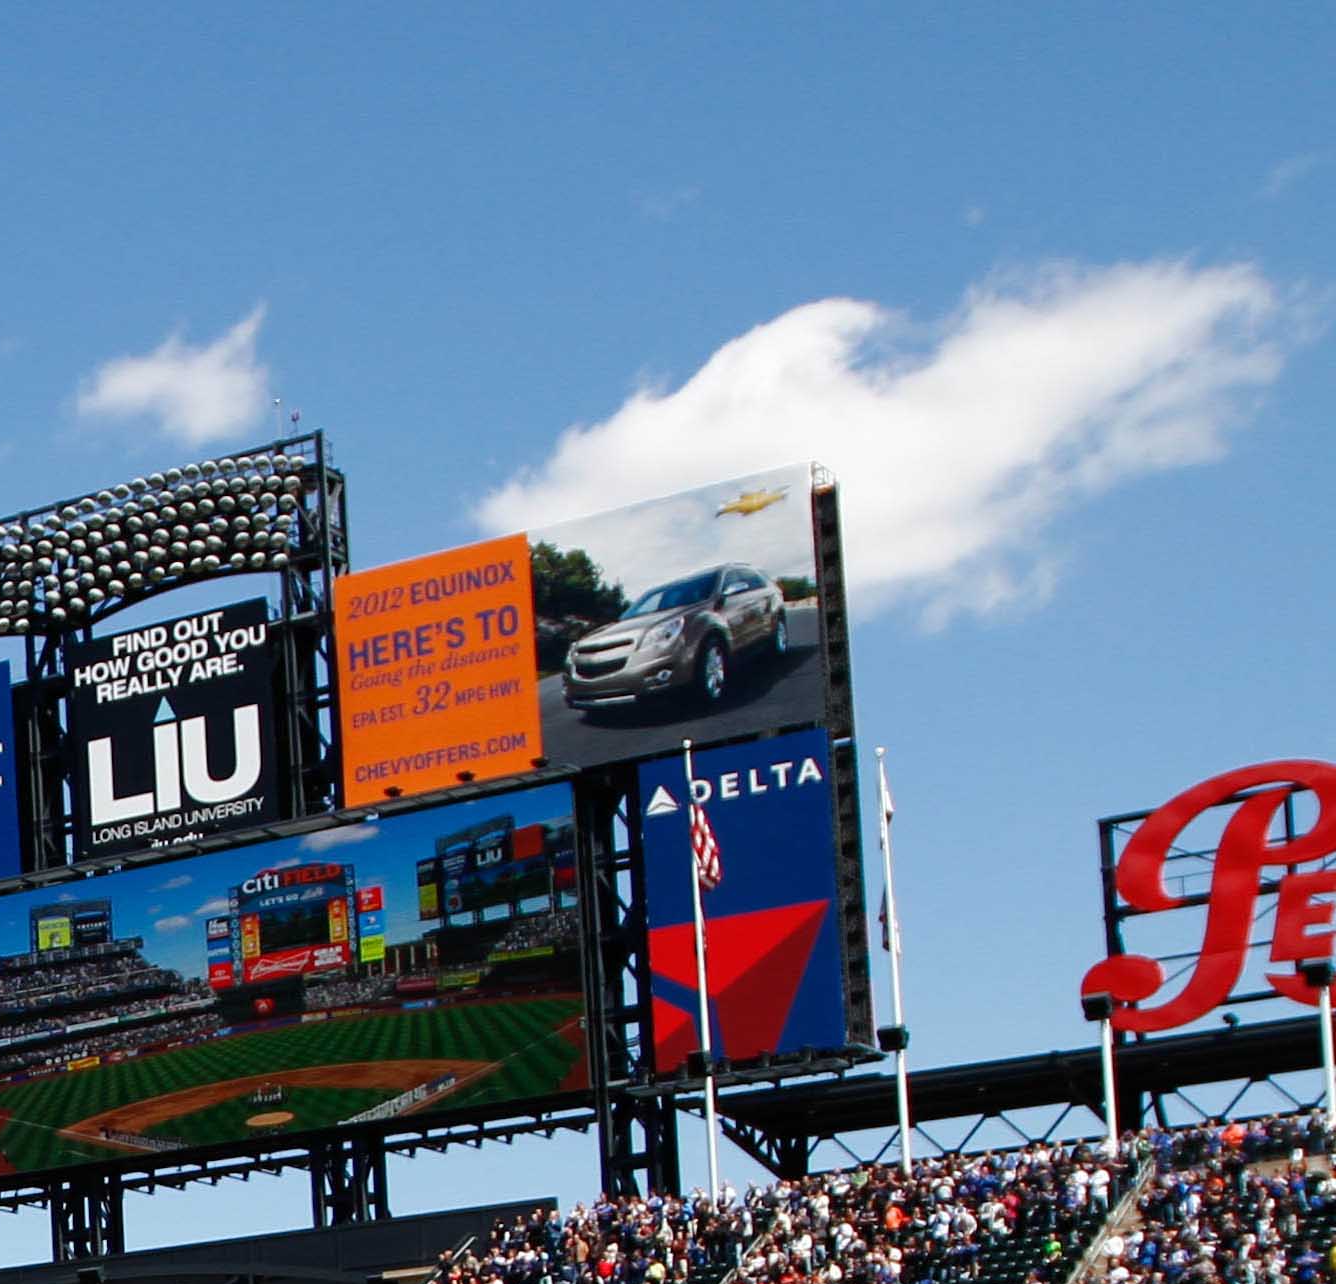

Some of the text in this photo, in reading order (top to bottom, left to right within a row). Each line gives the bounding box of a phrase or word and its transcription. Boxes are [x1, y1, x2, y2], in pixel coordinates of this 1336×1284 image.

[348, 561, 515, 620] 2012 EQUINOX
[75, 624, 266, 687] HOW GOOD YOU
[113, 612, 223, 656] FIND OUT
[349, 605, 518, 671] HERE'S TO
[96, 653, 243, 703] REALLY ARE.
[408, 659, 435, 678] the
[441, 643, 519, 671] distance
[353, 681, 485, 729] EPA 32 MPG
[88, 704, 261, 826] LIU
[355, 732, 527, 782] CHEVYOFFERS.COM
[691, 757, 823, 802] DELTA
[93, 823, 131, 844] LONG
[134, 814, 181, 834] ISLAND
[184, 797, 264, 825] UNIVERSITY
